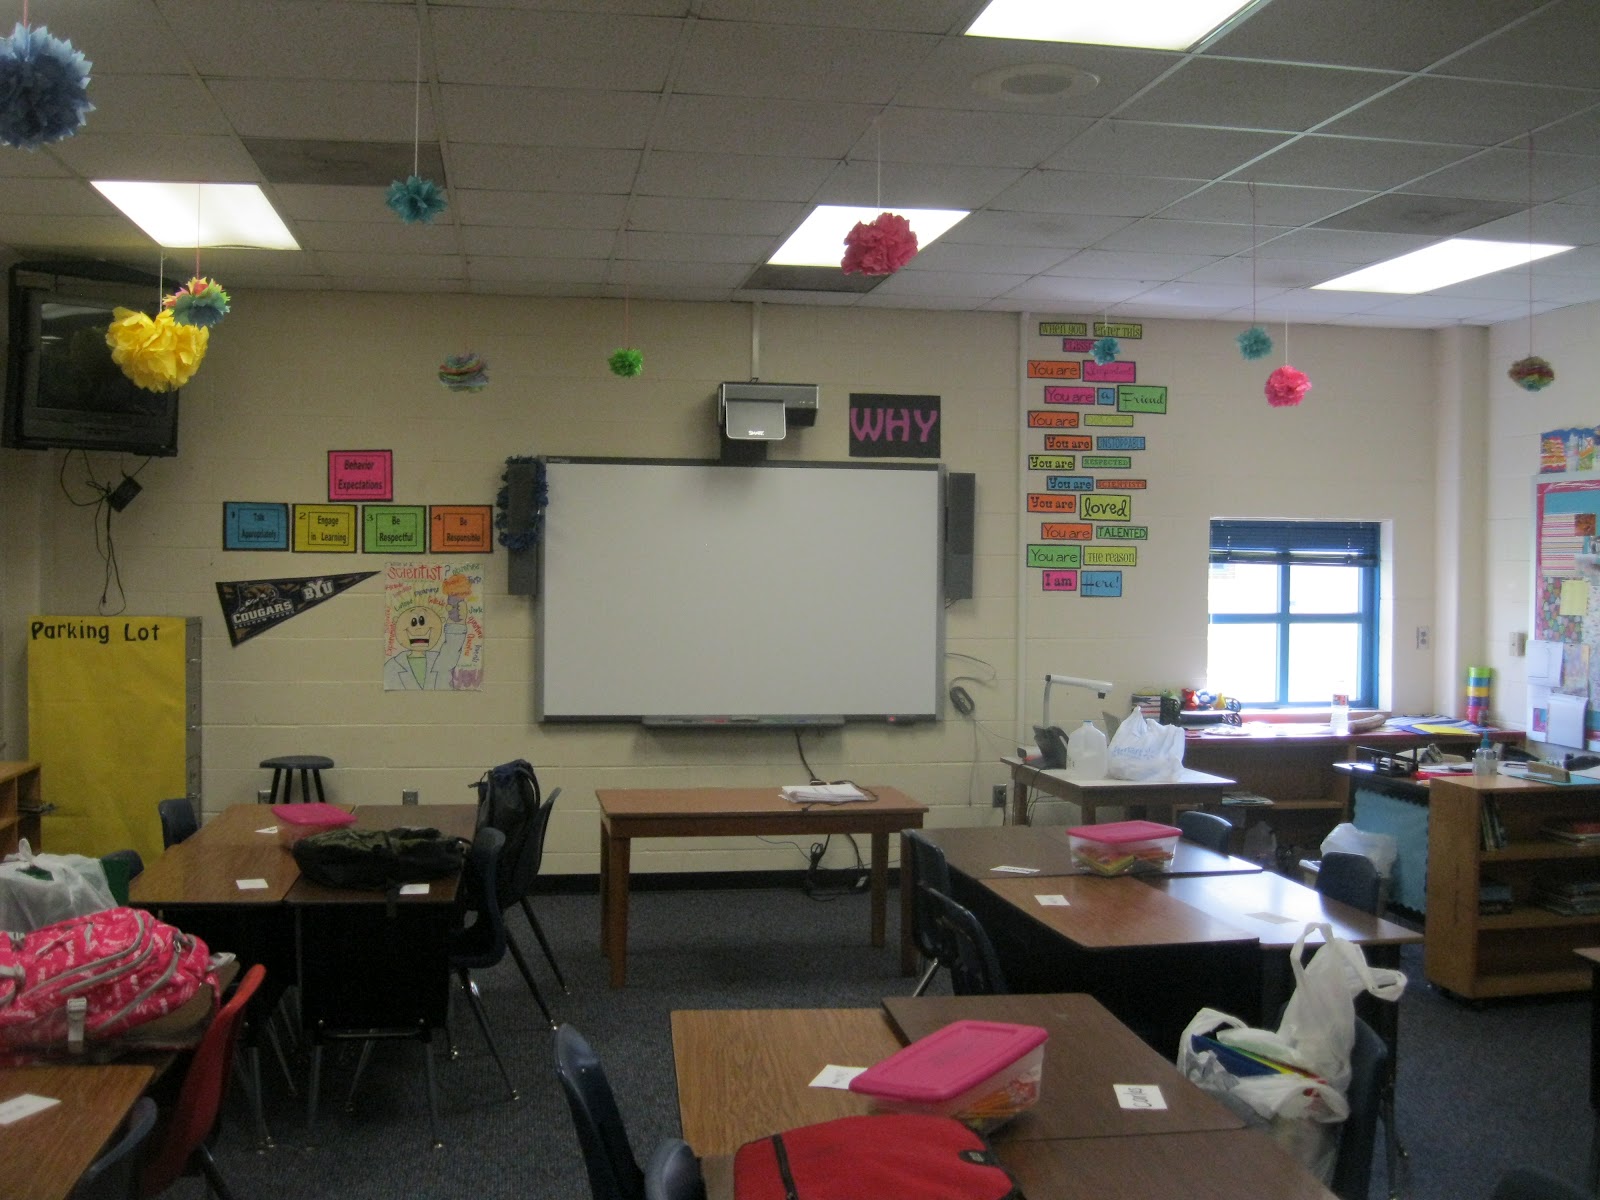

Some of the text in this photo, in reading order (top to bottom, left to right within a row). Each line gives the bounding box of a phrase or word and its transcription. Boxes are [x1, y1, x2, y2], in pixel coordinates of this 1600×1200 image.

[1030, 362, 1078, 376] You are
[1046, 388, 1094, 402] You are
[1101, 391, 1110, 400] a
[1120, 391, 1164, 410] Friend
[850, 407, 938, 443] WHY
[1030, 413, 1053, 426] You
[1055, 417, 1077, 427] are
[1046, 436, 1090, 449] You are
[344, 459, 375, 471] Behavior
[1030, 456, 1074, 468] You are
[338, 479, 383, 491] Expectations
[1048, 477, 1092, 489] You are
[1030, 496, 1074, 509] You are
[1084, 497, 1127, 517] loved
[299, 512, 307, 520] 2
[317, 515, 340, 527] Engage
[391, 515, 401, 526] Be
[459, 516, 468, 526] Be
[310, 532, 347, 543] in Learning
[379, 532, 414, 544] Respectful
[446, 532, 481, 543] Responsible
[1043, 525, 1090, 539] You are
[1098, 527, 1146, 538] TALENTED
[1030, 548, 1078, 563] You are
[1045, 573, 1072, 587] I am
[303, 578, 334, 600] BYU
[232, 601, 293, 624] COUGARS
[31, 620, 160, 644] Parking Lot
